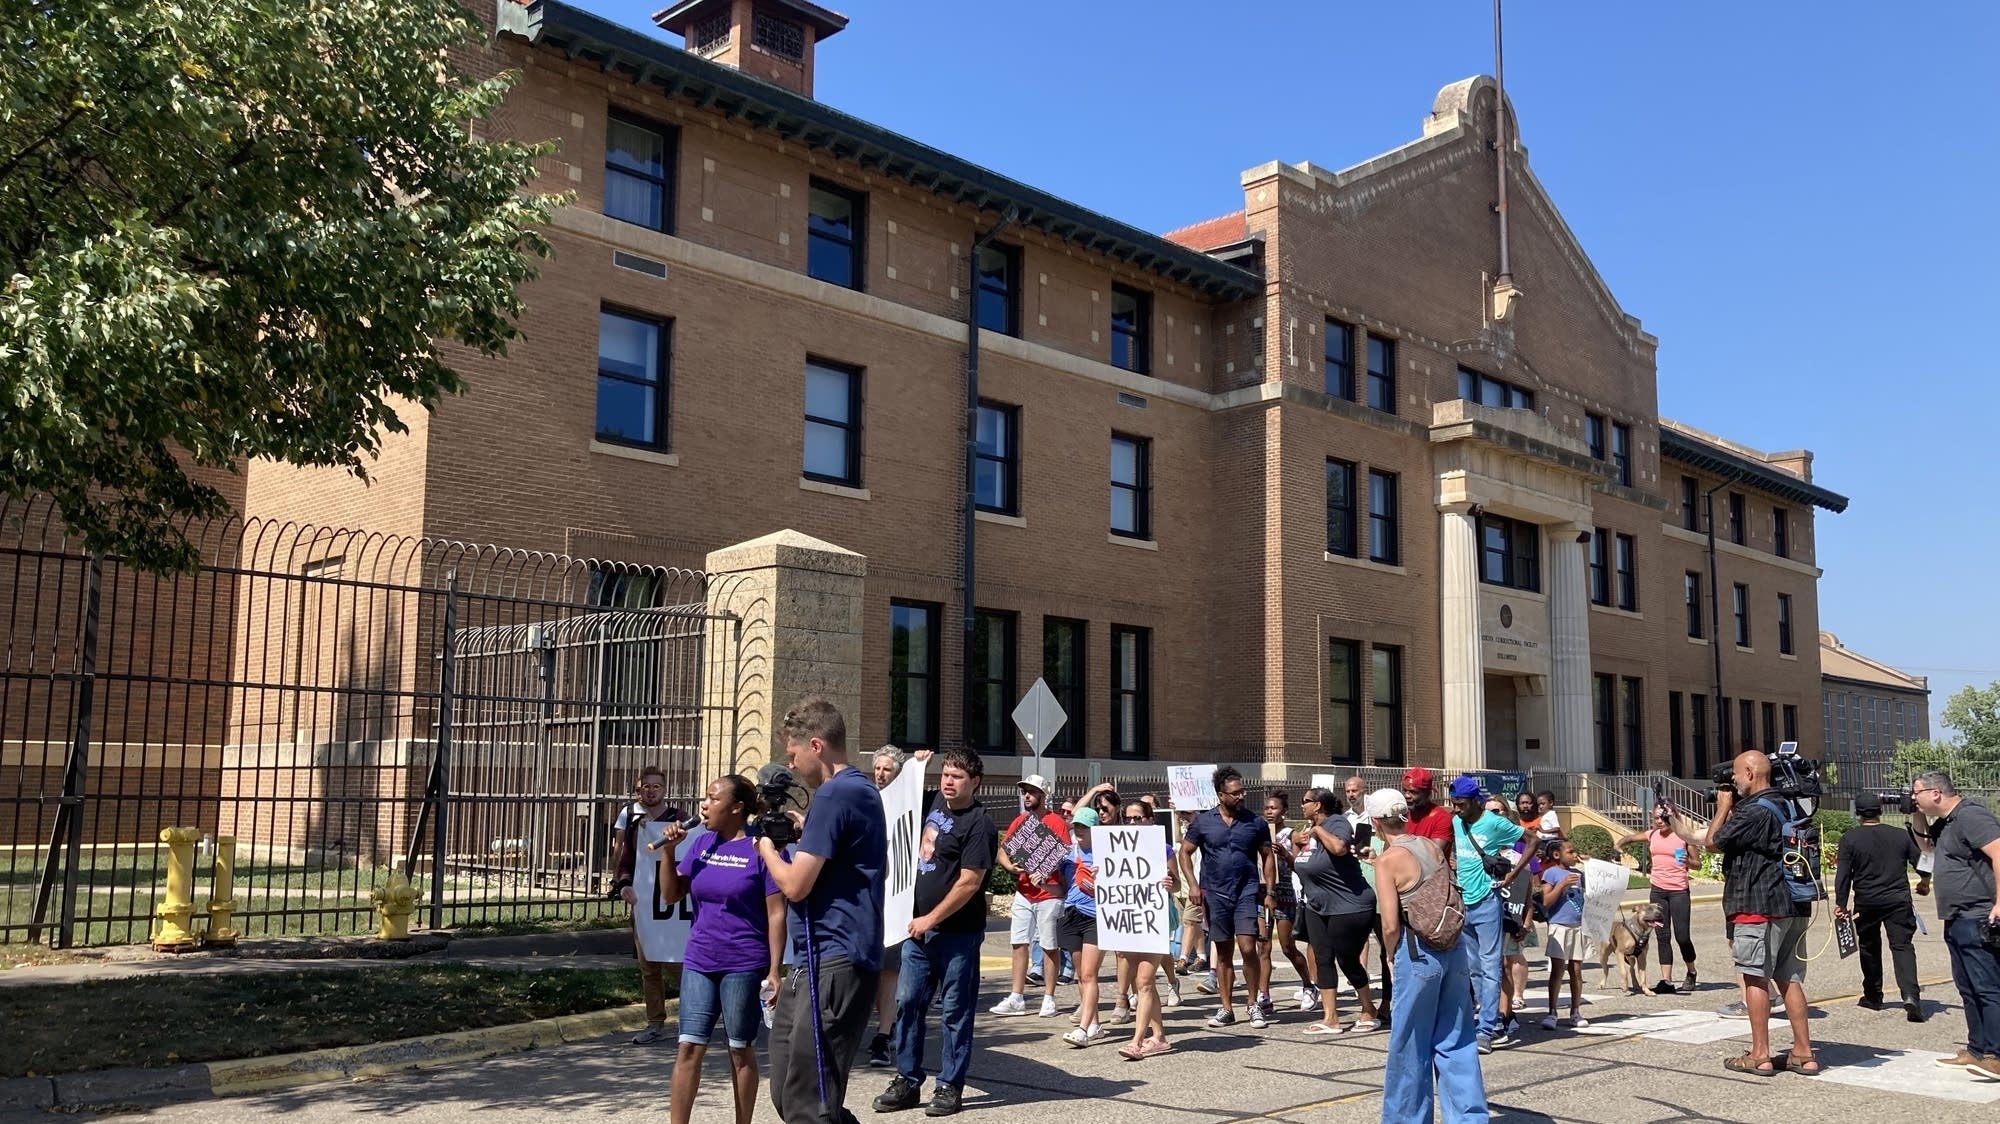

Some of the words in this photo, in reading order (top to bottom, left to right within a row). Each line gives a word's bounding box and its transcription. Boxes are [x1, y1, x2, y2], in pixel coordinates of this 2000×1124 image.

[1175, 766, 1193, 780] FREE
[1502, 783, 1520, 791] APPLY
[1006, 815, 1040, 856] JUSTICE
[1022, 832, 1041, 854] FOR
[1109, 830, 1139, 853] MY
[1025, 834, 1057, 871] MARVIN
[1104, 856, 1151, 880] DAD
[1096, 881, 1165, 910] DESERVES
[1101, 907, 1160, 935] WATER
